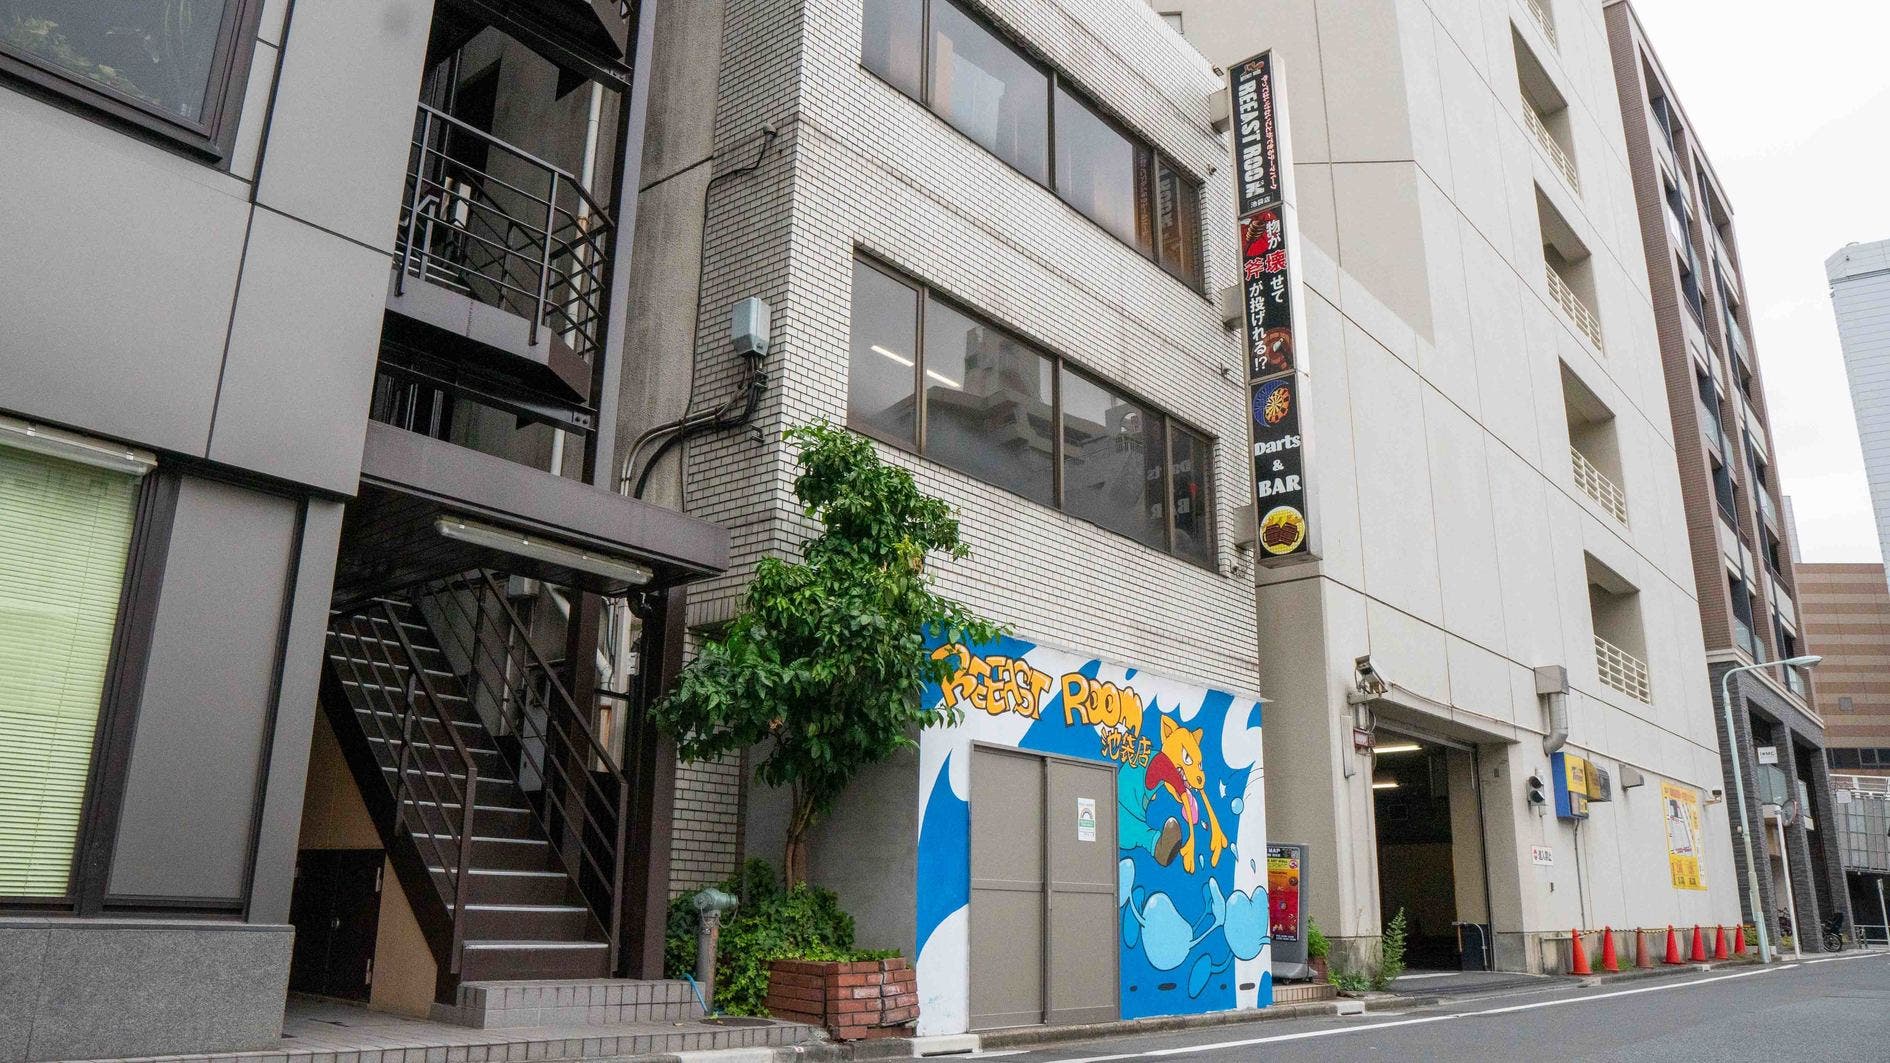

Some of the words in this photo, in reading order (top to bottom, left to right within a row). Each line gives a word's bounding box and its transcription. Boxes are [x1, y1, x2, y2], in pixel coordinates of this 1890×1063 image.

[1238, 82, 1262, 144] REEAST
[1243, 144, 1266, 199] ROOM
[1266, 219, 1288, 303] 物が壊せて
[1254, 434, 1301, 457] Darts
[1272, 459, 1285, 472] &
[1258, 474, 1302, 498] BAR
[931, 643, 1053, 720] REEAST
[1061, 672, 1143, 738] ROOM
[1101, 728, 1152, 768] 池袋店
